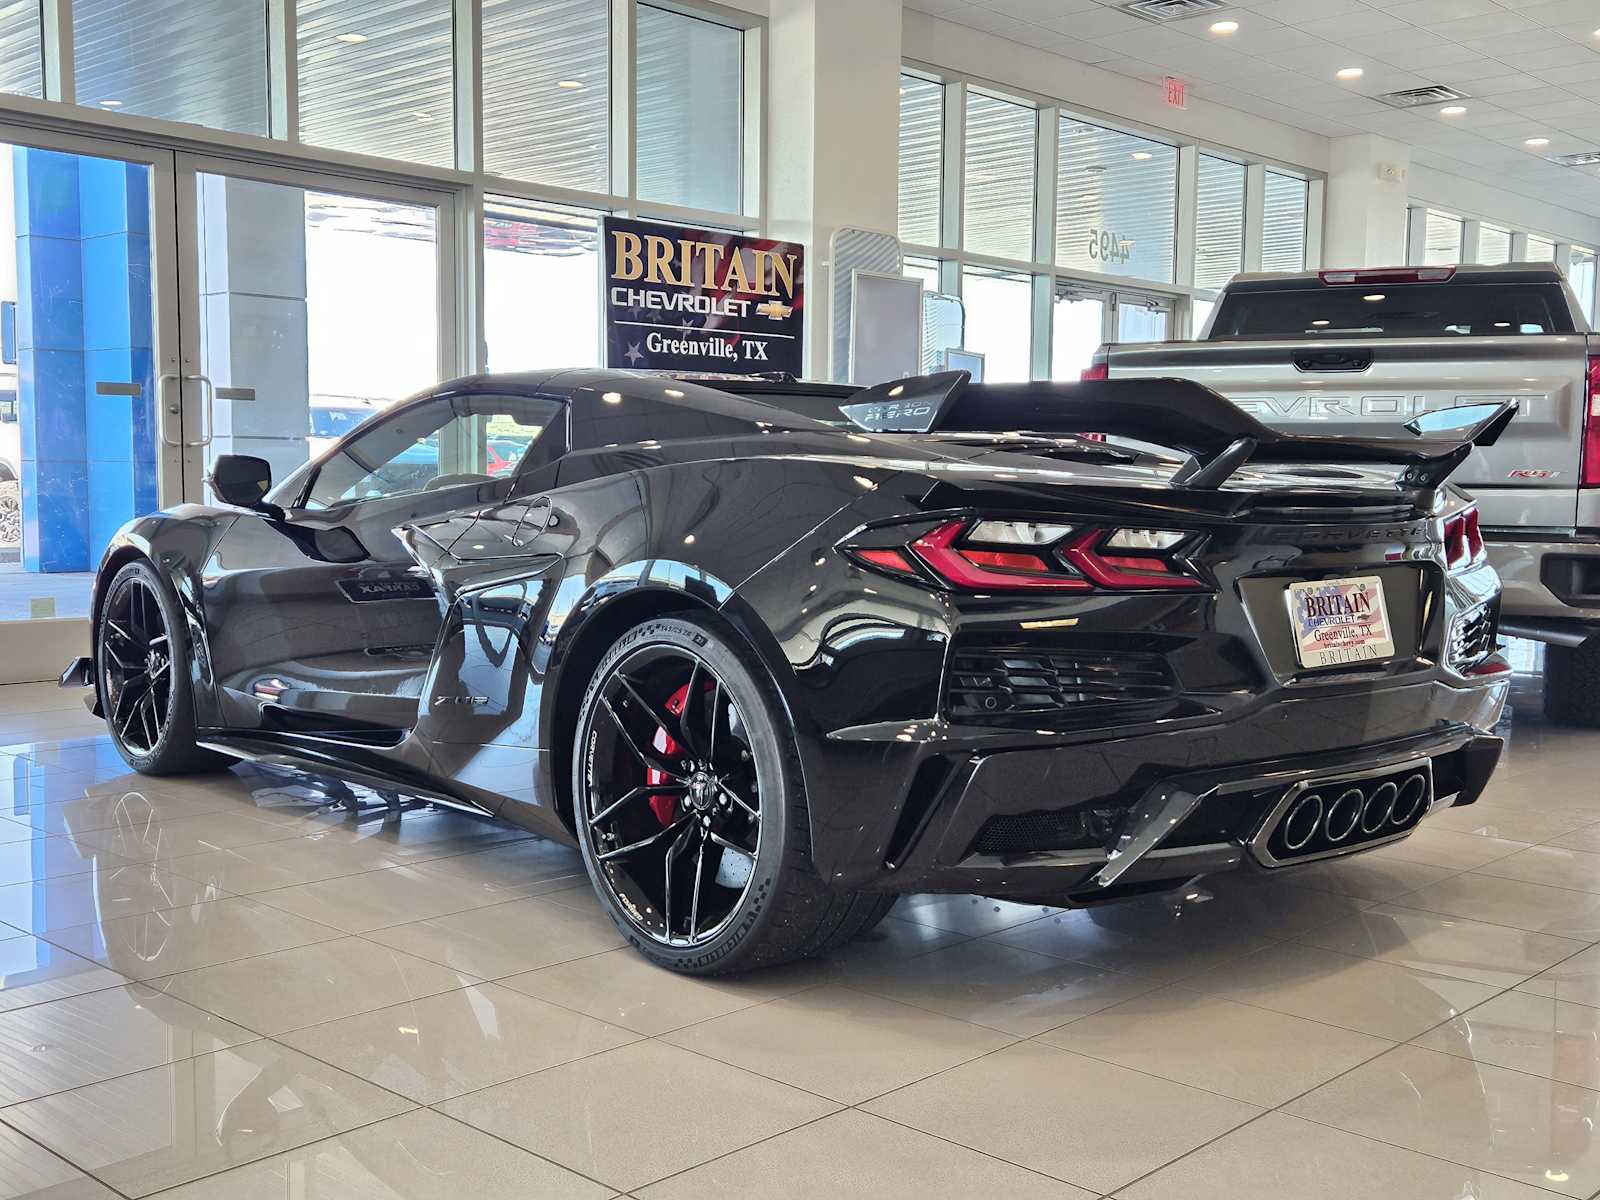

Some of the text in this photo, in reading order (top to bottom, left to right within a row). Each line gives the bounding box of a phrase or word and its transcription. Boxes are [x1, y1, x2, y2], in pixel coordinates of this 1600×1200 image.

[1168, 80, 1184, 106] EXIT
[611, 231, 798, 299] BRITAIN
[611, 286, 751, 318] CHEVROLET
[646, 332, 769, 362] Greenville, TX
[1304, 592, 1371, 618] BRITAIN
[1308, 614, 1356, 628] CHEVROLET
[1314, 624, 1373, 642] Greenville, TX
[1320, 644, 1377, 664] BRITAIN
